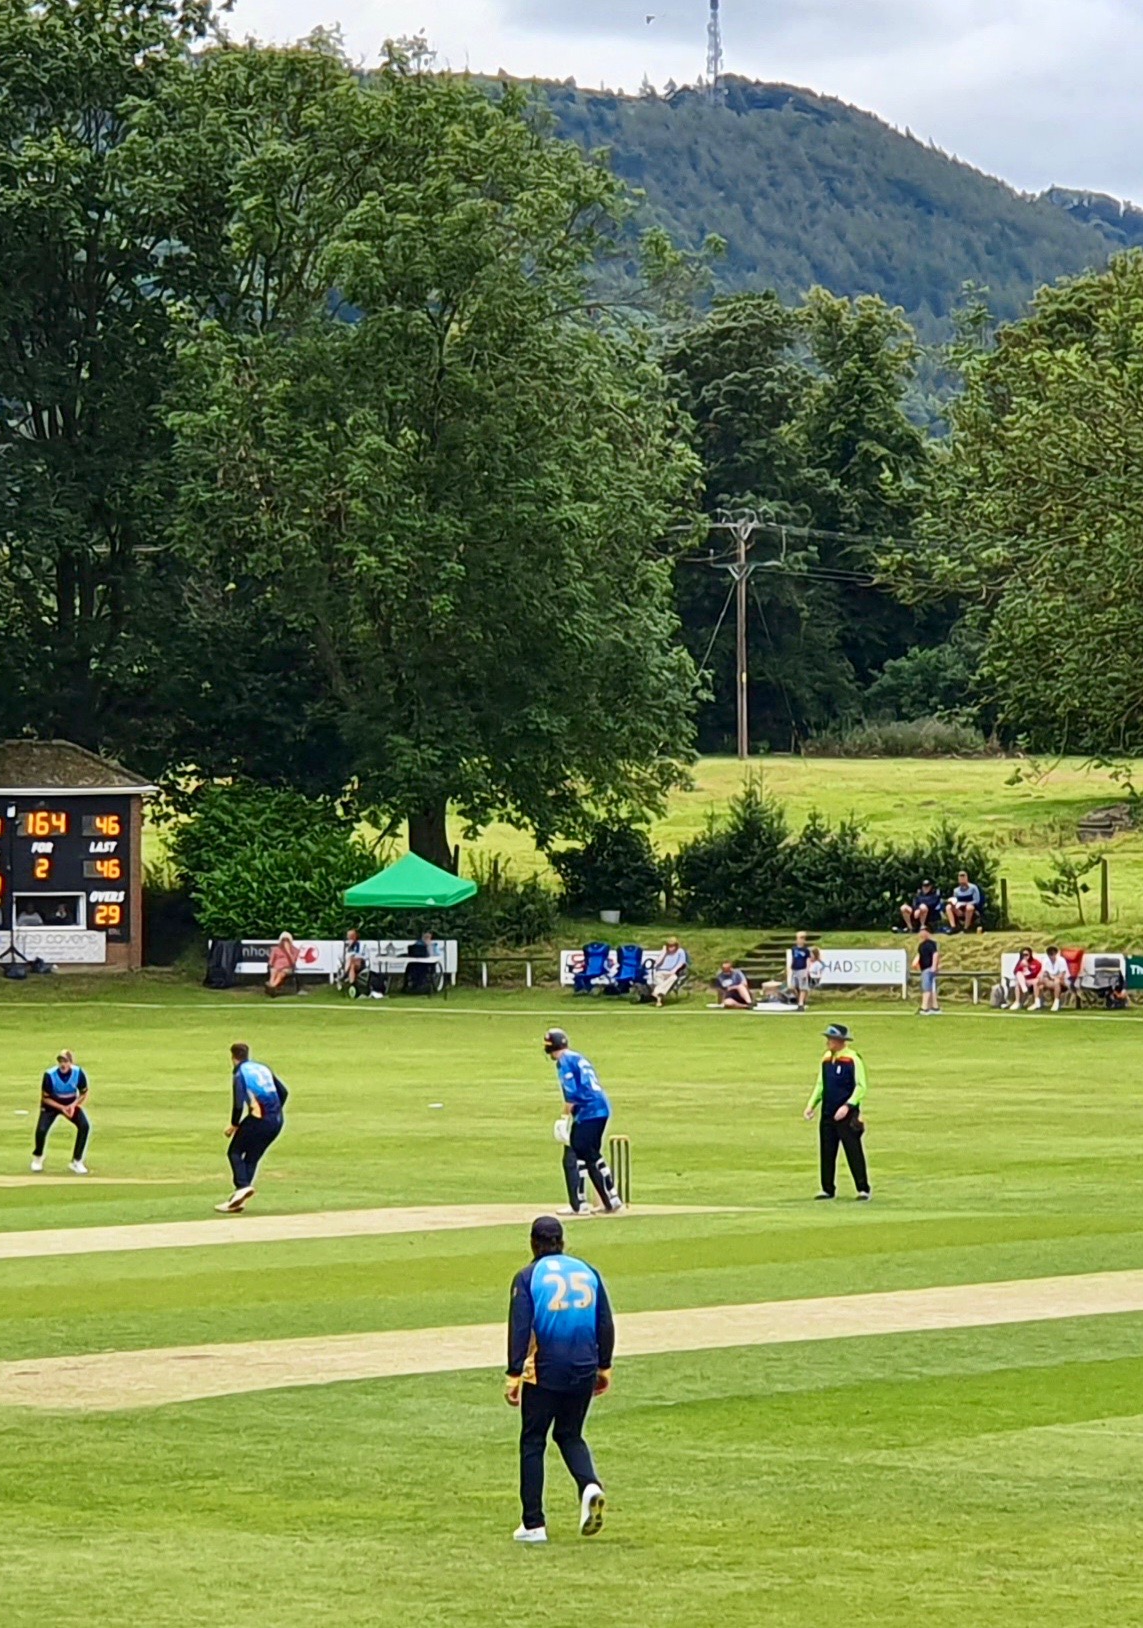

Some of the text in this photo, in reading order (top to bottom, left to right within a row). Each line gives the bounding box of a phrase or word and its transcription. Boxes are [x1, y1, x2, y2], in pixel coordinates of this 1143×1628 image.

[27, 811, 67, 835] 164
[95, 815, 120, 835] 46
[31, 842, 54, 853] FOR
[89, 841, 118, 853] LAST
[35, 858, 49, 878] 2
[95, 858, 120, 878] 46
[89, 891, 125, 903] OVERS
[95, 905, 120, 924] 29
[543, 1271, 594, 1311] 25
